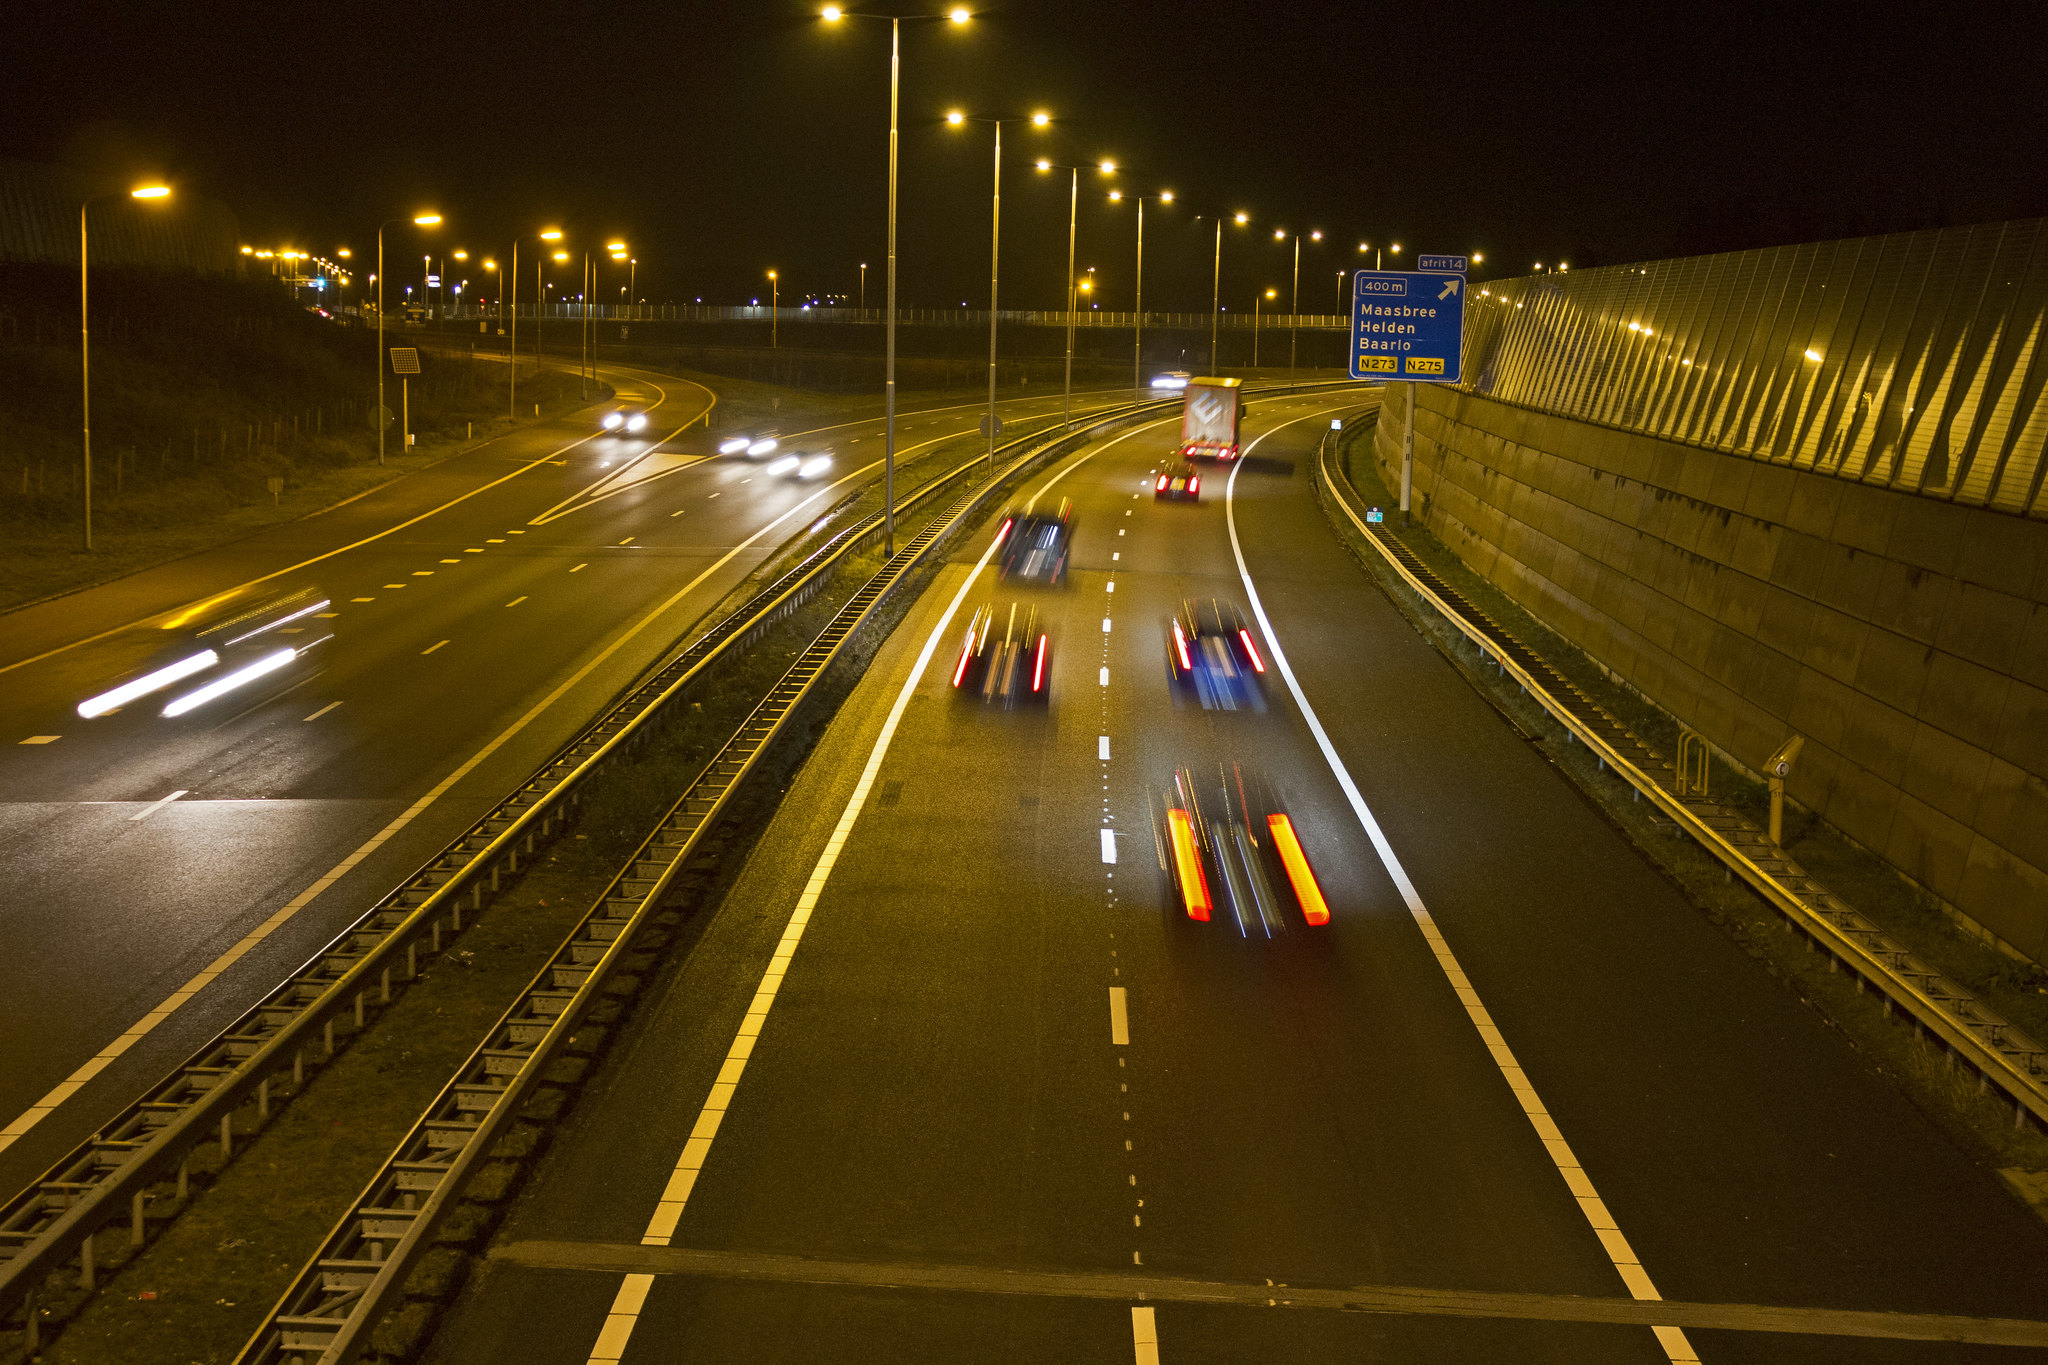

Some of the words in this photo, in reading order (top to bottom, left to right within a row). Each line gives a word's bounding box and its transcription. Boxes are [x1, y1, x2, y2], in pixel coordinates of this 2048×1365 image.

[1422, 259, 1446, 268] afrit
[1449, 259, 1463, 269] 14
[1365, 282, 1389, 292] 400
[1391, 284, 1403, 292] m
[1361, 304, 1437, 318] Maasbree
[1360, 321, 1415, 334] Helden
[1359, 338, 1411, 351] Baarlo
